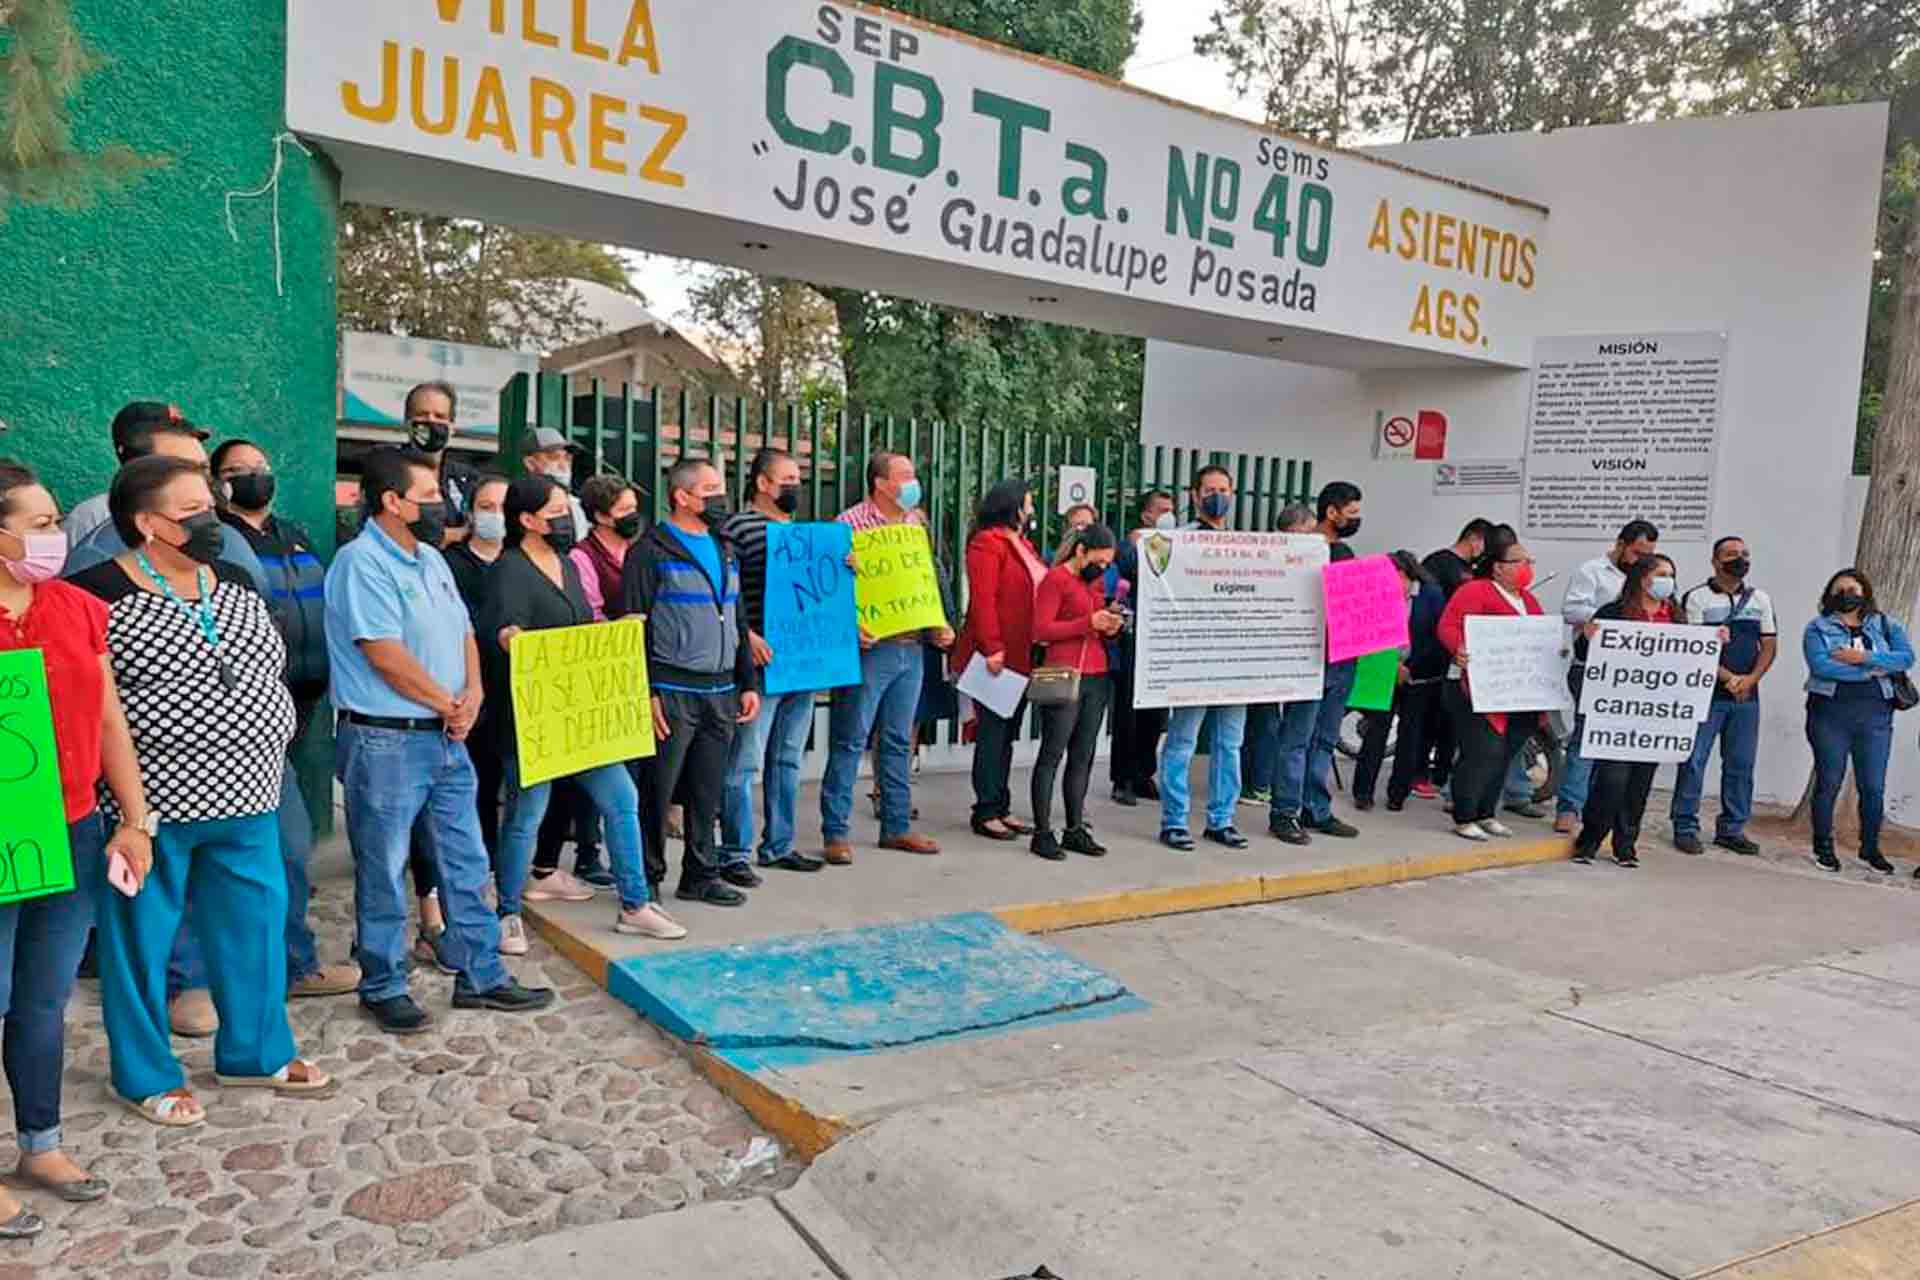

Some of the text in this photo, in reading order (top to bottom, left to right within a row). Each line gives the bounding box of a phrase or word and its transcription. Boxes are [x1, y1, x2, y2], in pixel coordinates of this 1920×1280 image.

[433, 0, 661, 75] LLA
[817, 5, 919, 62] SEP
[341, 40, 689, 187] JUAREZ
[940, 198, 1168, 290] Guadalupe
[1253, 174, 1333, 268] 40
[1368, 200, 1538, 289] ASIENTOS
[1409, 285, 1489, 348] AGS.
[1598, 341, 1658, 355] MISIÓN
[1591, 458, 1647, 471] VISIÓN
[792, 554, 839, 614] NO
[517, 635, 549, 674] LA
[1600, 629, 1718, 657] Exigimos
[516, 679, 543, 720] NO
[552, 670, 580, 712] SE
[1586, 662, 1714, 690] el pago de
[1594, 697, 1694, 719] canasta
[1588, 727, 1692, 752] materna
